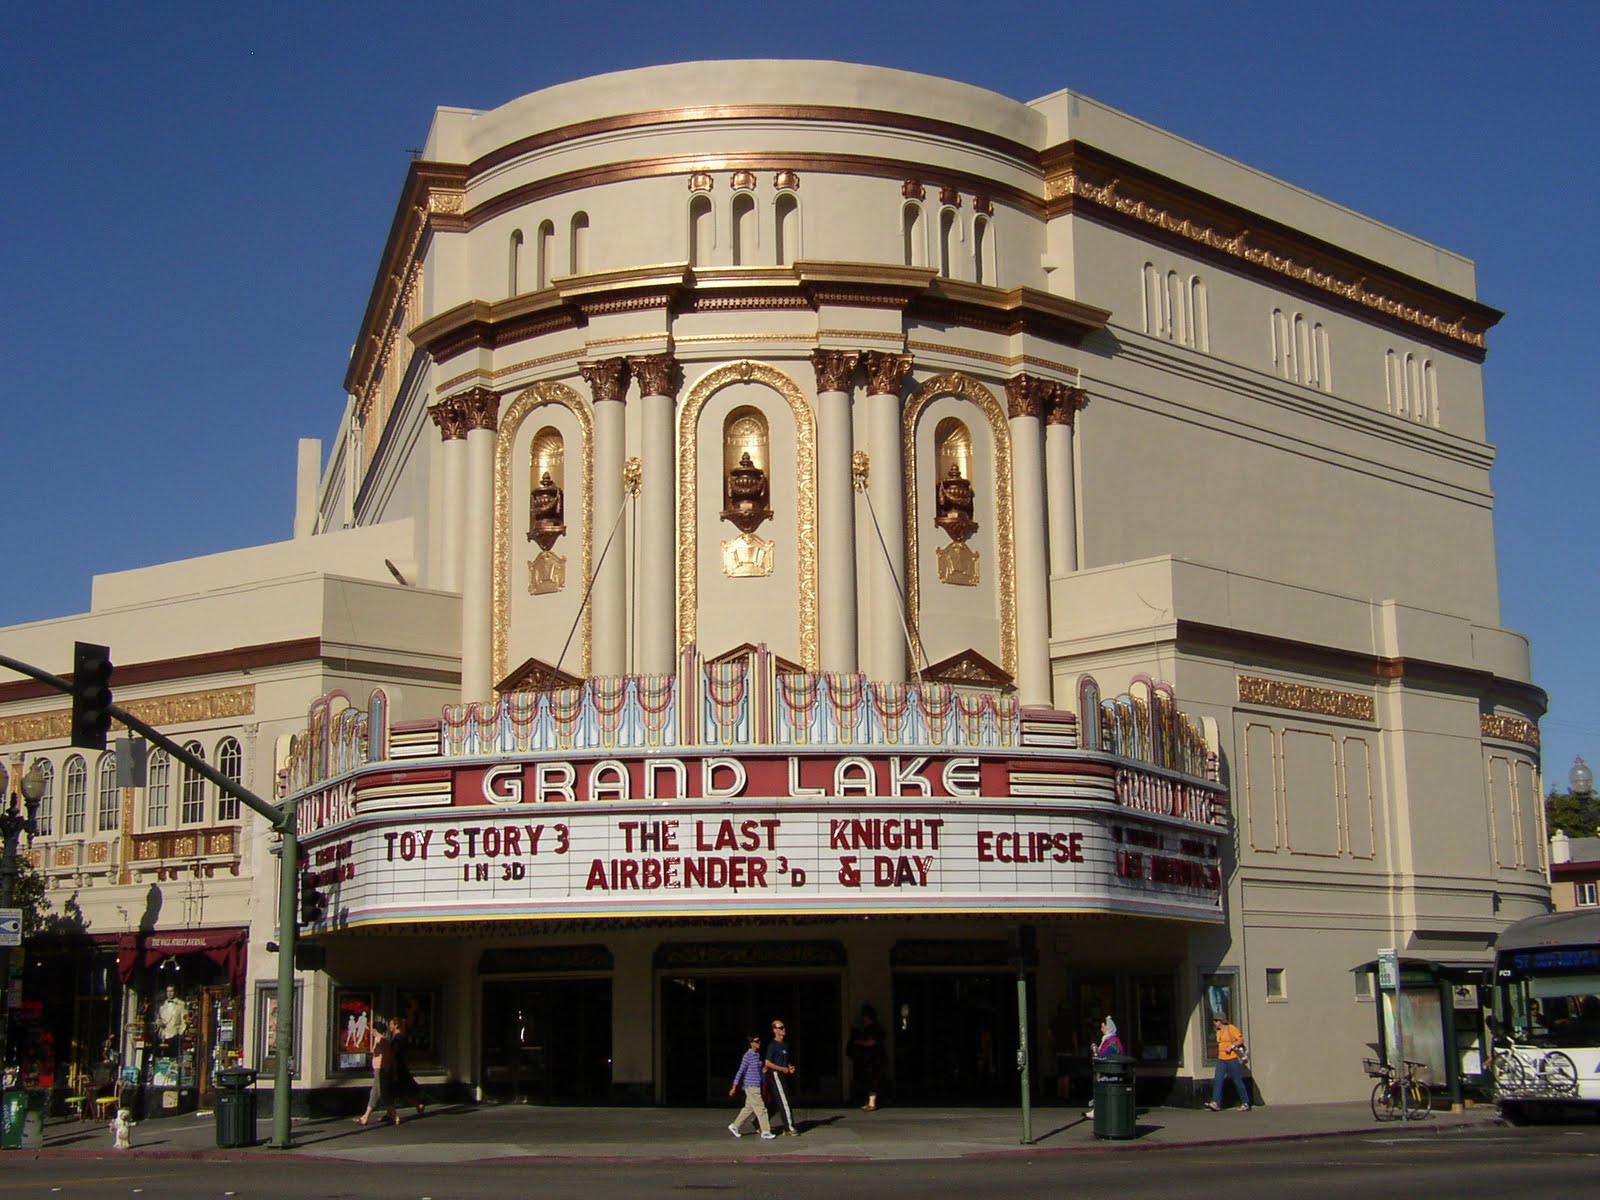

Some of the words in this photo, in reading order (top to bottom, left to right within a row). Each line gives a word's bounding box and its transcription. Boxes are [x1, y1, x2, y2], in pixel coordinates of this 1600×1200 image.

[482, 756, 748, 806] GRAND
[787, 755, 982, 798] LAKE
[1116, 768, 1174, 816] GRAND
[1175, 784, 1216, 826] LAKE
[296, 795, 320, 836] AND
[323, 780, 357, 829] LAKE
[384, 828, 434, 863] TOY
[443, 823, 545, 860] STORY
[553, 823, 571, 855] 3
[618, 819, 680, 853] THE
[695, 818, 781, 852] LAST
[830, 818, 945, 850] KNIGHT
[976, 830, 1085, 864] ECLIPSE
[463, 862, 489, 882] IN
[501, 862, 527, 881] 3D
[585, 856, 769, 890] AIRBENDER
[838, 855, 862, 887] &
[872, 855, 934, 887] DAY
